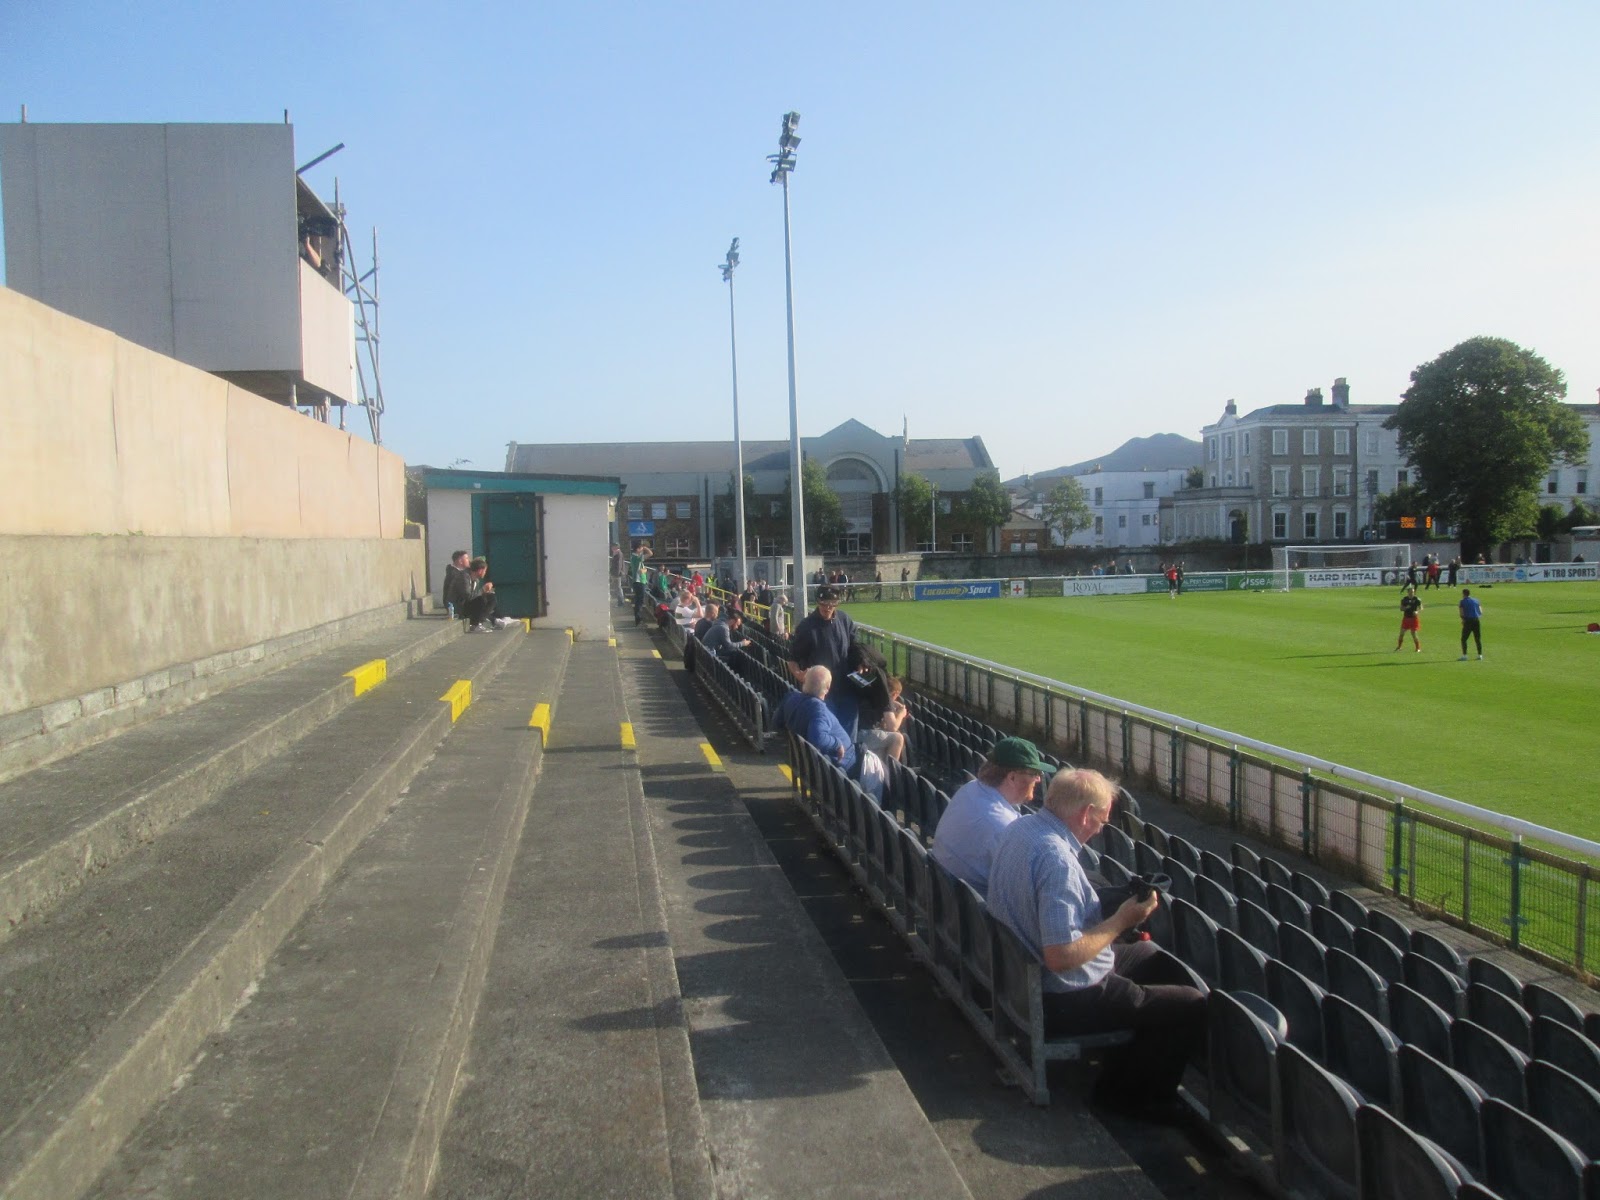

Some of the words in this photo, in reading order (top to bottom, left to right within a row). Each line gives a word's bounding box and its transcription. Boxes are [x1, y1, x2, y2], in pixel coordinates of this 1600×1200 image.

[1567, 568, 1596, 577] SPORTS
[1249, 578, 1266, 586] sse
[968, 585, 992, 595] Sport
[1072, 582, 1102, 593] ROYAL
